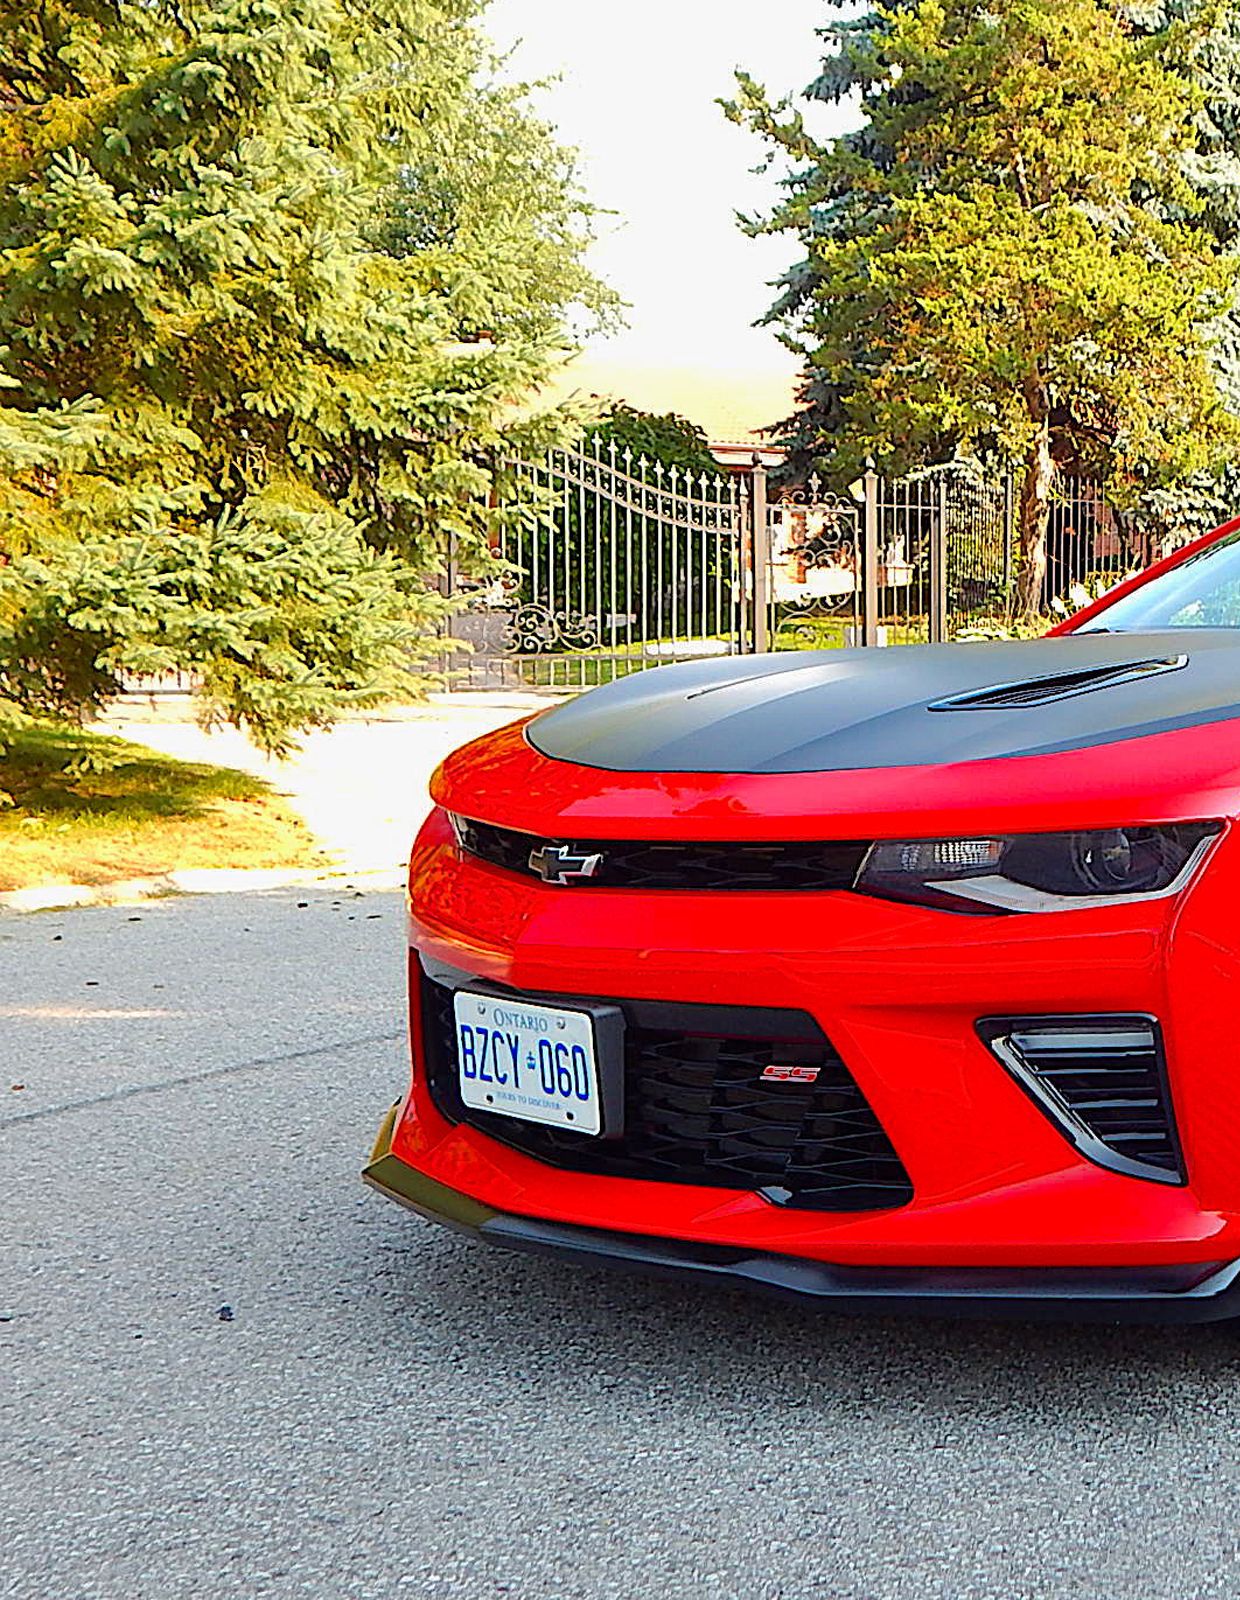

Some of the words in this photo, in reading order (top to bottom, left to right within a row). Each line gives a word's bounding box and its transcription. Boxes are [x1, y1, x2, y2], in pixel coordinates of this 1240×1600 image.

[493, 1008, 548, 1032] ONTARIO
[460, 1025, 520, 1088] BZCY
[539, 1039, 589, 1101] 060
[760, 1065, 821, 1082] SS
